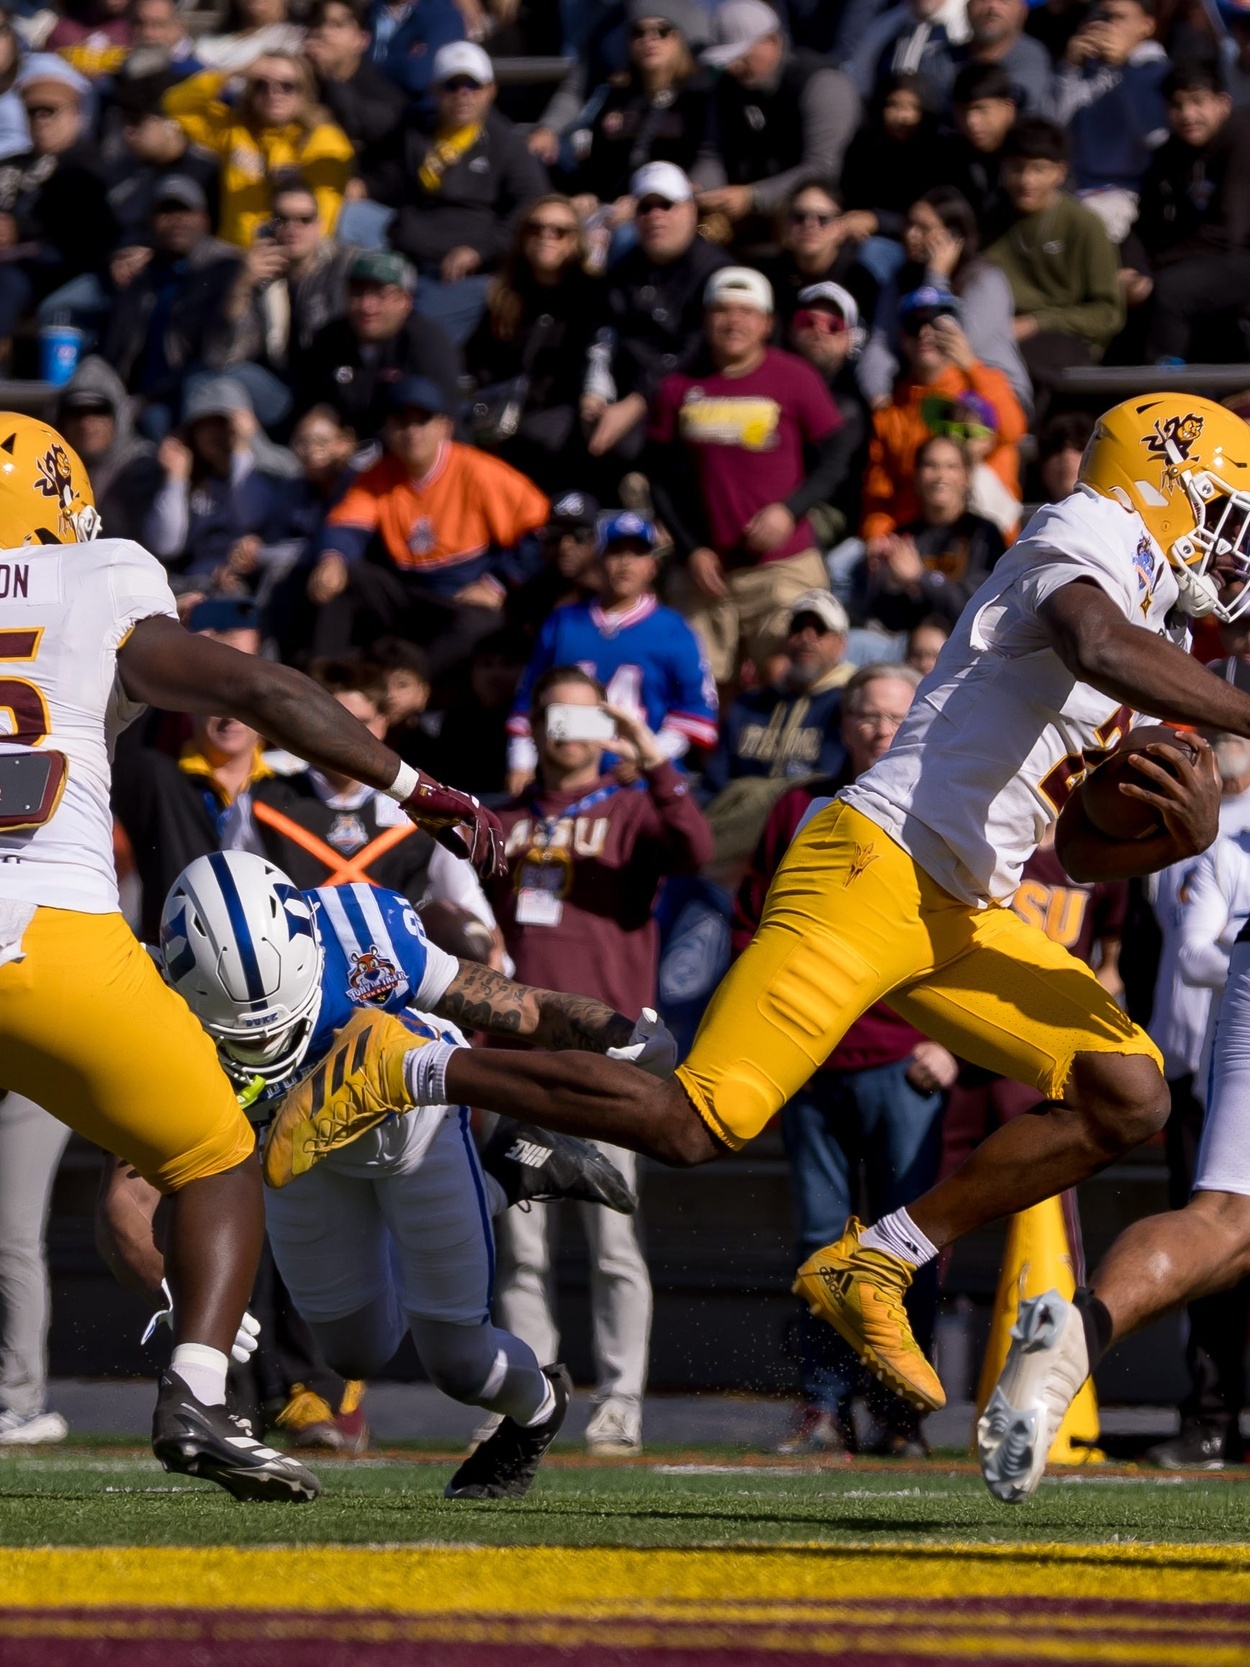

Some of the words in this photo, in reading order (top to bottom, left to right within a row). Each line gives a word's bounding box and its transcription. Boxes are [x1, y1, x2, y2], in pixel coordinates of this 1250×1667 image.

[347, 983, 371, 1000] TONY
[382, 971, 406, 986] TIGER
[245, 1012, 278, 1028] DUKE
[504, 1138, 553, 1168] NIKE
[819, 1265, 848, 1308] adidas
